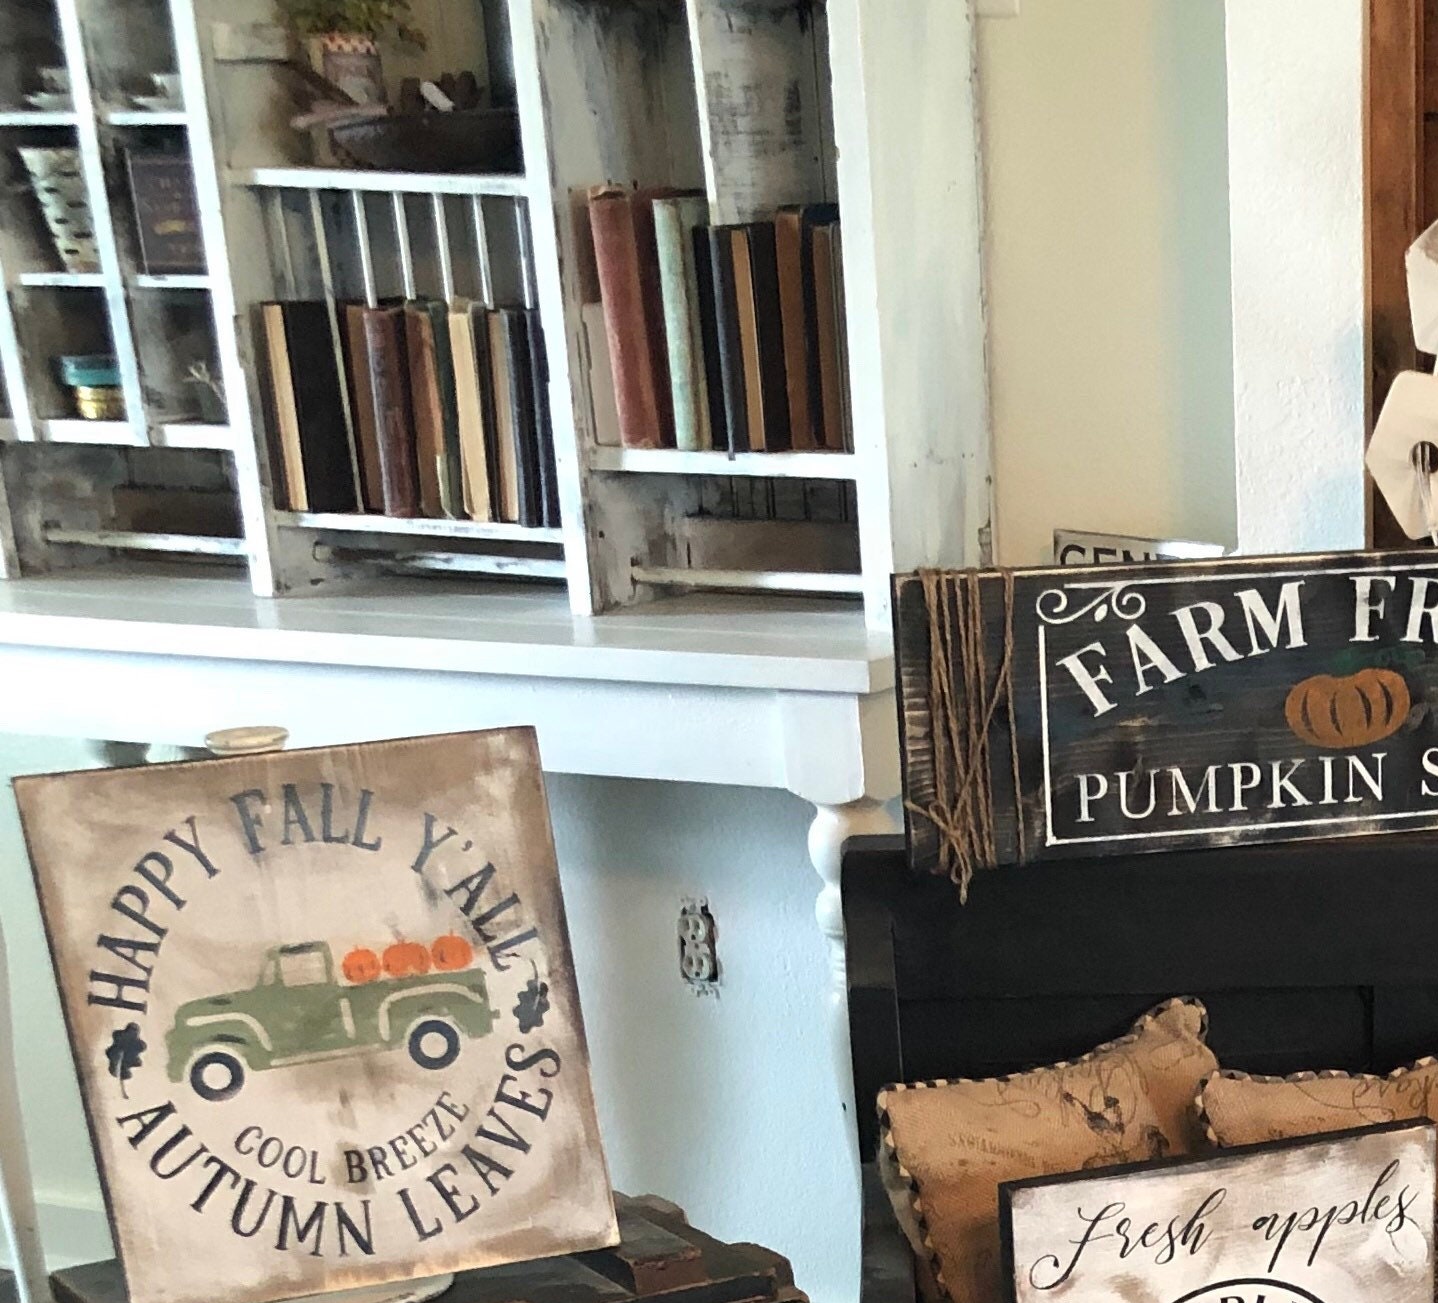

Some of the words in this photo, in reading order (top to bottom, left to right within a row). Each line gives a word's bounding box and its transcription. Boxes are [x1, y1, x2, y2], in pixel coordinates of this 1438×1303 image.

[1056, 579, 1308, 718] FARM
[1076, 752, 1388, 823] PUMPKIN
[88, 816, 220, 1015] HAPPY
[229, 783, 382, 855] FALL
[410, 813, 538, 973] Y'ALL
[117, 1100, 377, 1258] AUTUMN
[397, 1042, 562, 1243] LEAVES
[234, 1125, 326, 1184] COOL
[345, 1090, 471, 1184] BREEZE
[1252, 1158, 1428, 1272] apples
